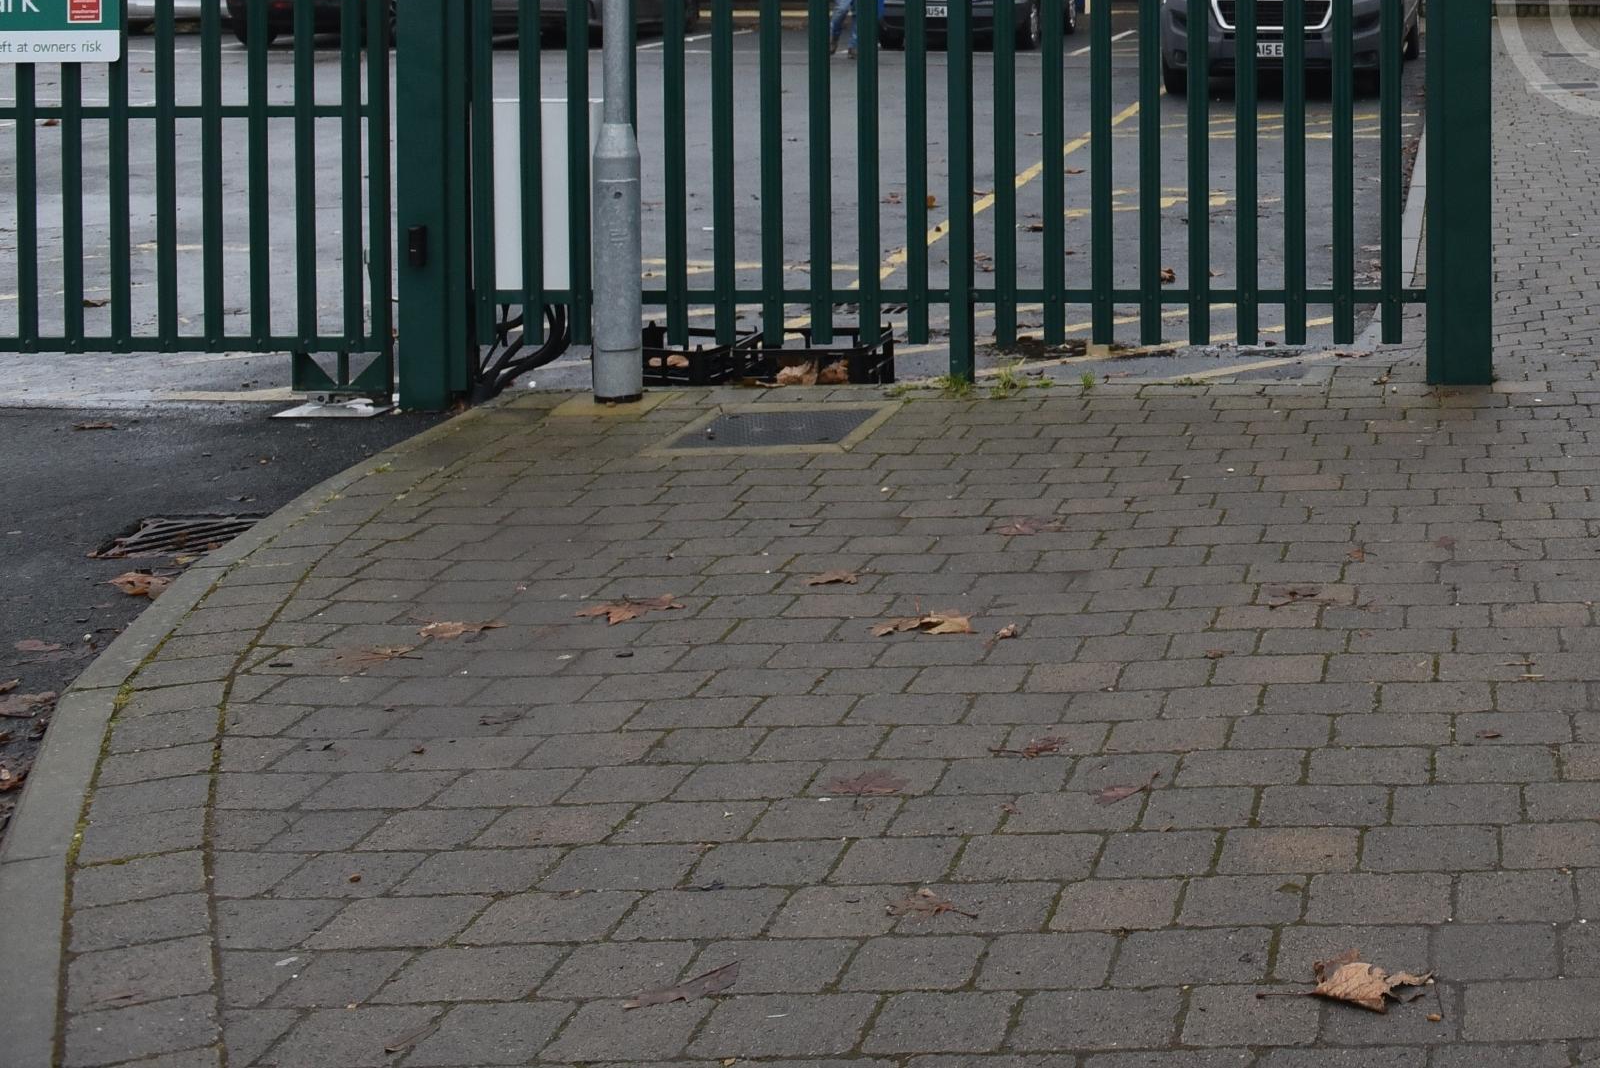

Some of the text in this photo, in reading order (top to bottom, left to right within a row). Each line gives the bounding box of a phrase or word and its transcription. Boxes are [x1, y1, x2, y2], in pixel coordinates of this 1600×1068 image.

[16, 42, 28, 52] at
[33, 43, 77, 53] owners
[81, 40, 102, 52] risk
